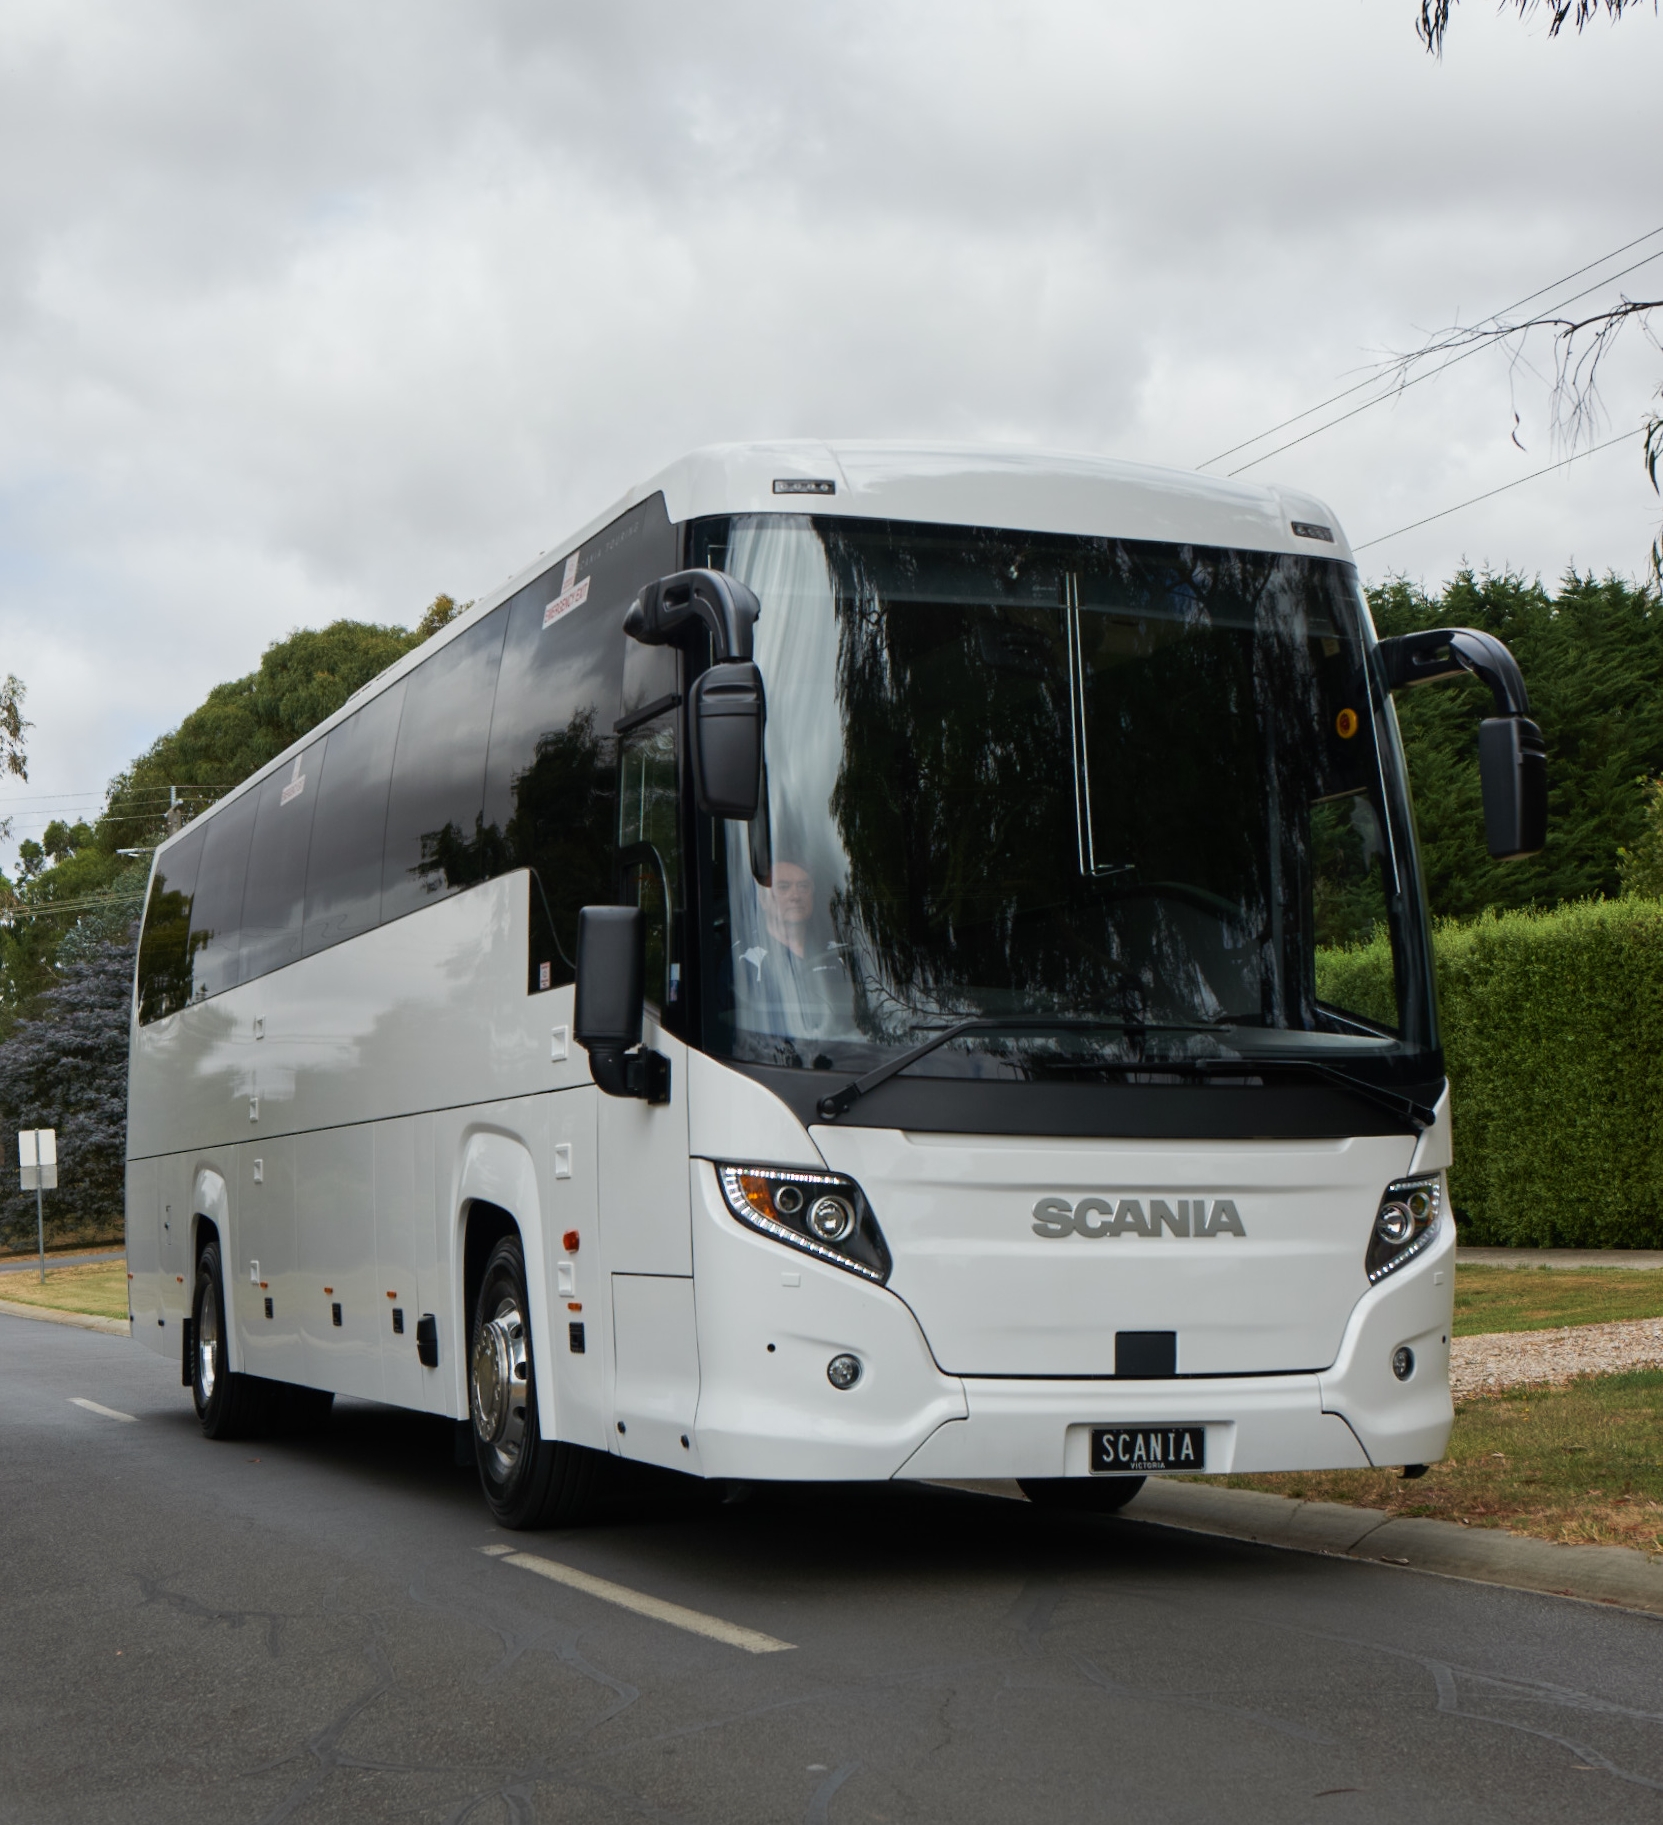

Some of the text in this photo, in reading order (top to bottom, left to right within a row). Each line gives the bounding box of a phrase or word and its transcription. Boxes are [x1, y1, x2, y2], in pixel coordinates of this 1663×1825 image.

[579, 521, 639, 572] CANIA TOURING
[544, 592, 575, 623] EMERGENCY
[574, 582, 588, 602] EXIT
[1031, 1197, 1247, 1239] SCANIA
[1102, 1432, 1195, 1462] SCANIA
[1130, 1461, 1166, 1469] VICTORIA
